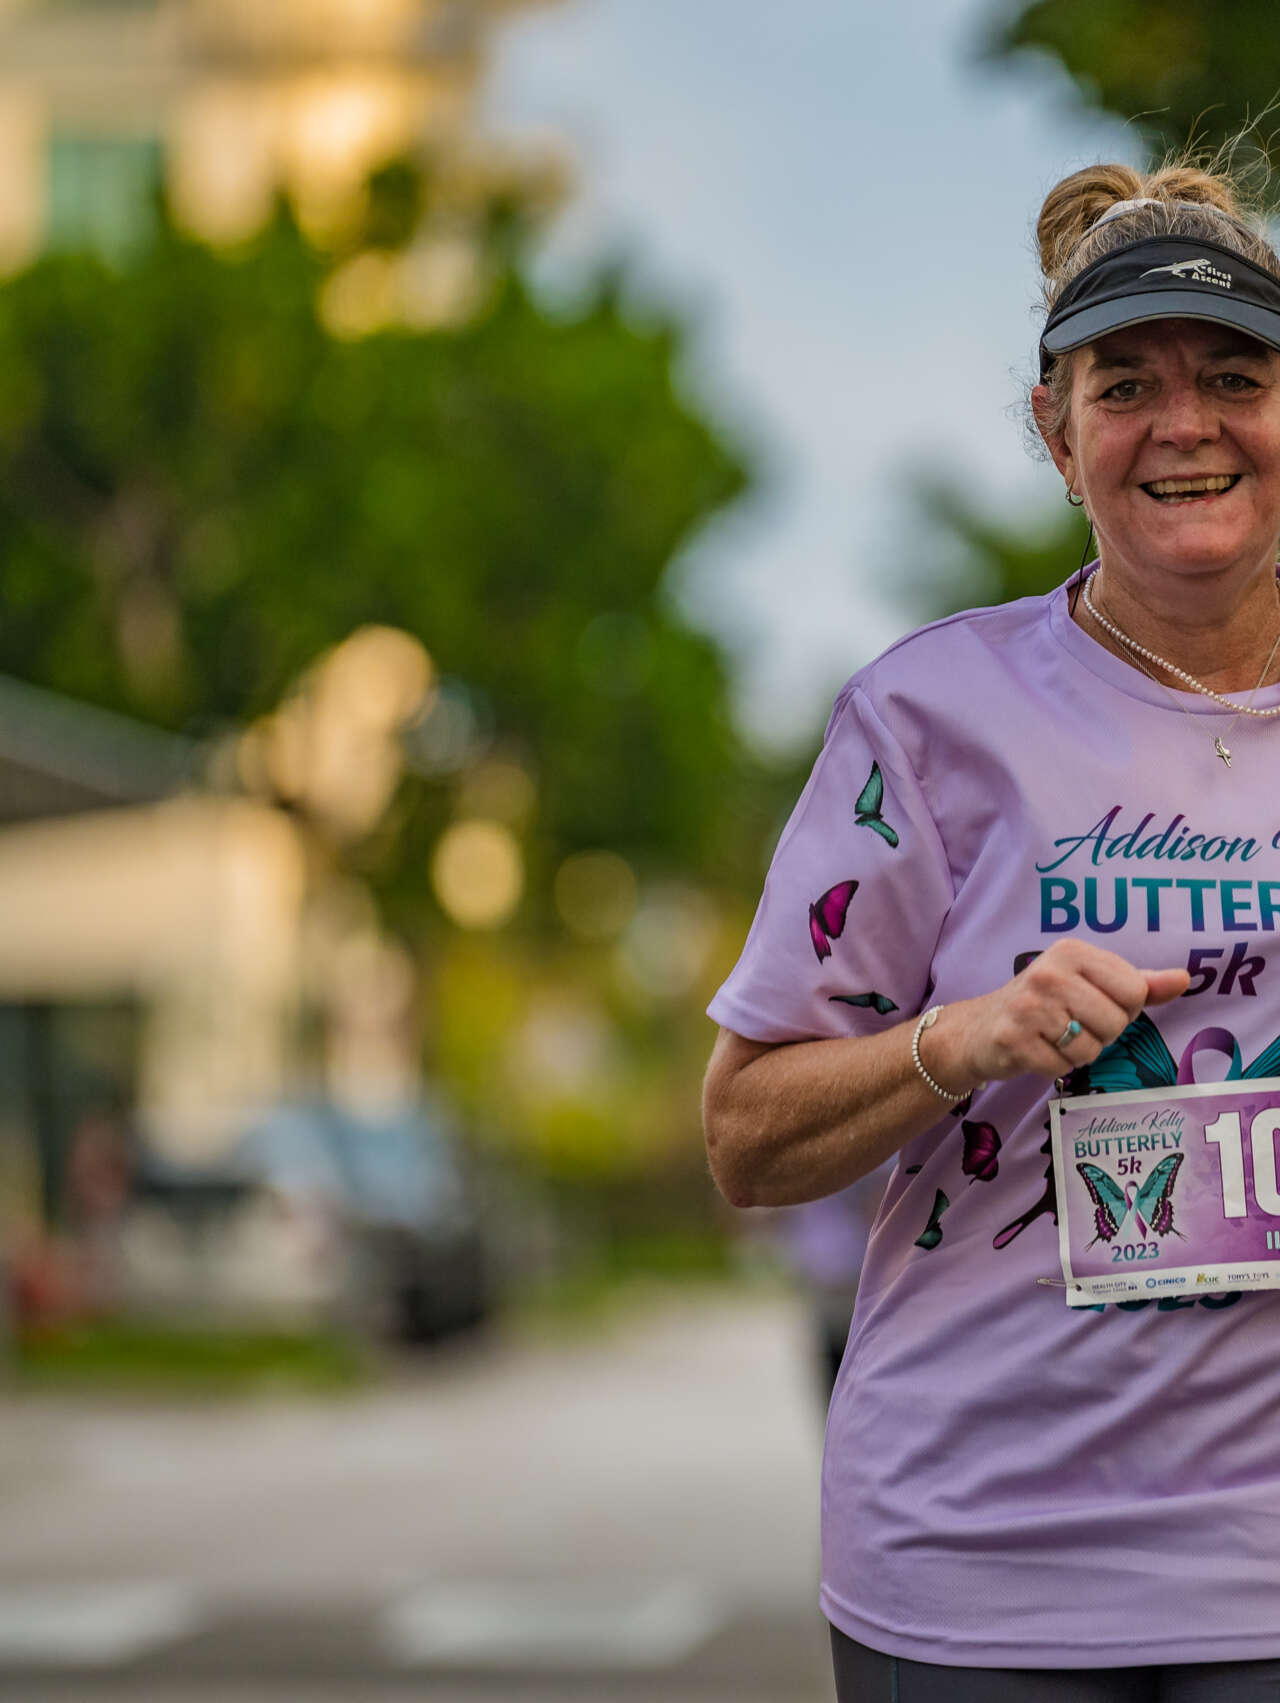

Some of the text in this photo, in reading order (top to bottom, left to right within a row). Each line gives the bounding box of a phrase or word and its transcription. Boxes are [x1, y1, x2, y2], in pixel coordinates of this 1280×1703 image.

[1035, 804, 1263, 874] Addison
[1179, 941, 1267, 998] 5k
[1073, 1108, 1185, 1140] Addison Kelly
[1074, 1131, 1183, 1159] BUTTERFLY
[1117, 1155, 1142, 1176] 5k
[1110, 1241, 1161, 1263] 2023
